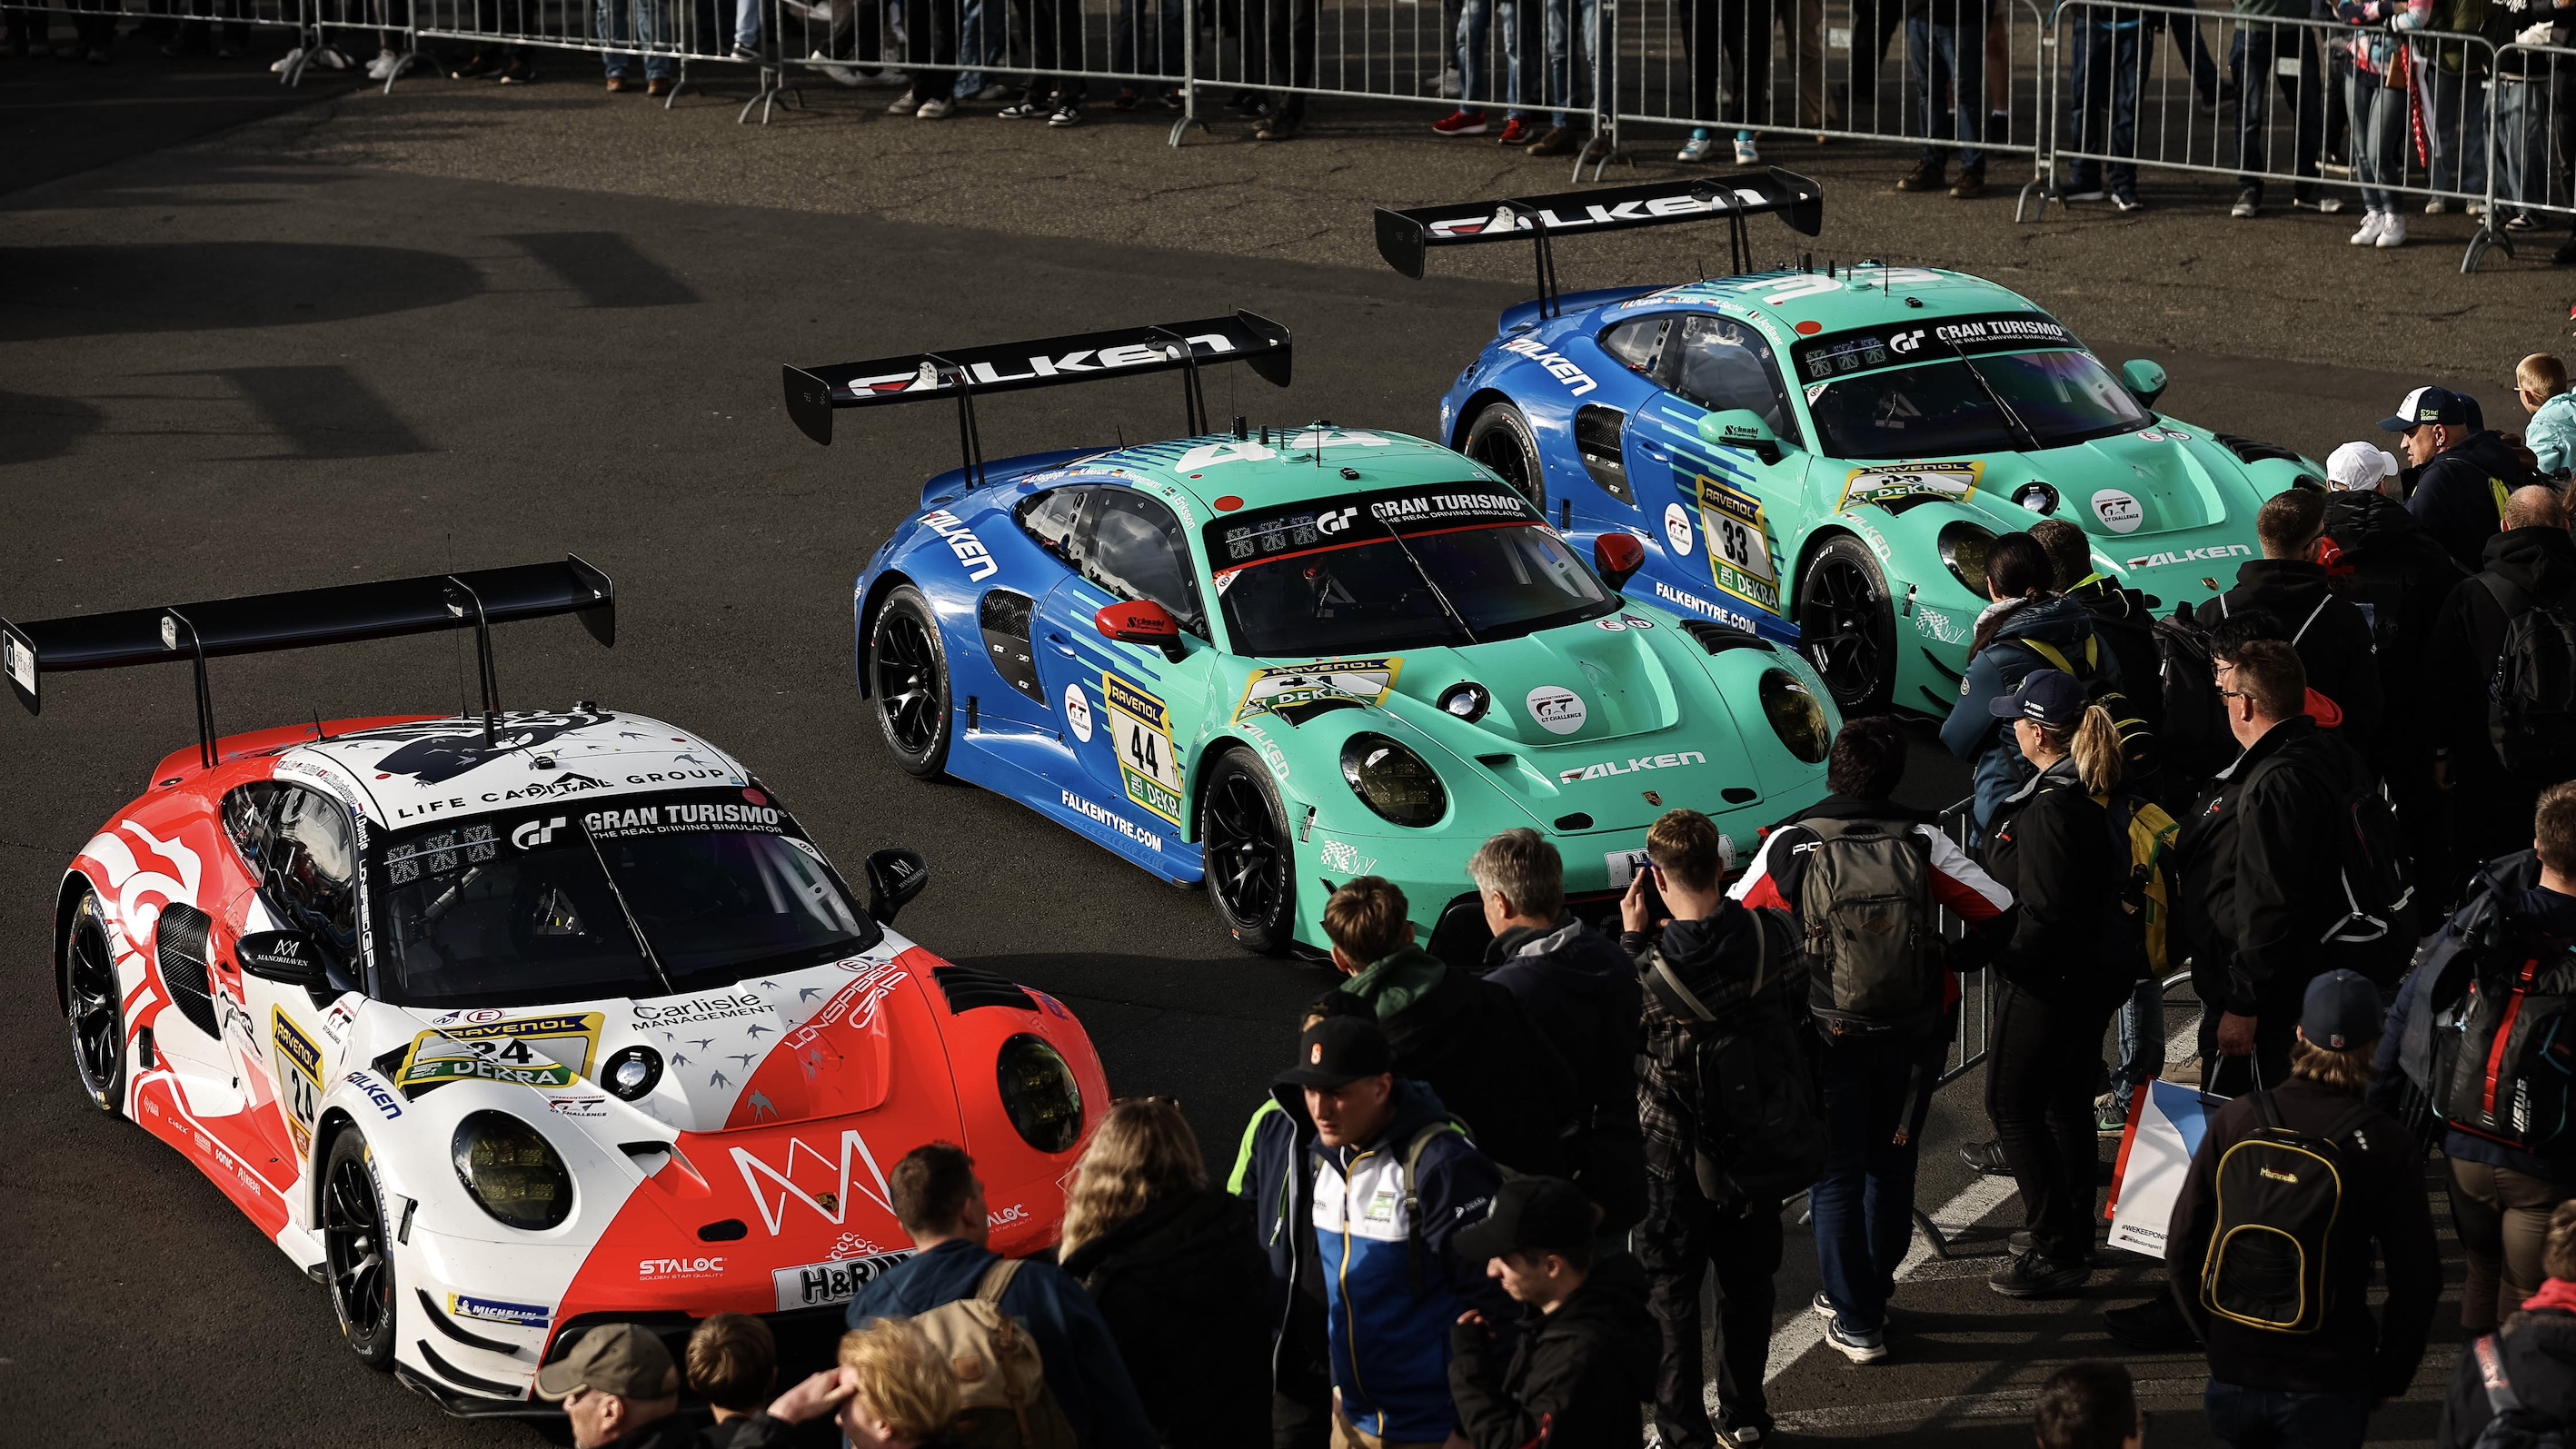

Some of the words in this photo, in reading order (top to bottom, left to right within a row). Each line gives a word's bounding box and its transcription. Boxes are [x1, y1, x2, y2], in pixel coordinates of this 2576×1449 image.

[1428, 188, 1768, 236] FALKEN
[1935, 322, 1986, 341] GRAN
[2023, 332, 2069, 342] SIMULATOR
[847, 332, 1238, 396] FALKEN
[1497, 338, 1598, 397] FALKEN
[1869, 462, 1965, 473] RAVENOL
[1169, 493, 1196, 531] J.Eriksson
[1370, 497, 1429, 520] GRAN
[1402, 513, 1430, 521] REAL
[1431, 510, 1471, 520] DRIVING
[1472, 509, 1527, 518] SIMULATOR
[1706, 488, 1755, 520] RAVENOL
[916, 509, 1000, 583] FALKEN
[1722, 518, 1748, 567] 33
[2124, 544, 2253, 571] FALKEN
[1736, 571, 1778, 610] DEKRA
[1656, 581, 1756, 634] FALKENTYRE.COM
[1272, 661, 1380, 675] RAVENOL
[1110, 685, 1160, 722] RAVENOL
[1550, 711, 1582, 721] CHALLENGE
[1130, 723, 1159, 779] 44
[1557, 750, 1707, 785] FALKEN
[397, 797, 466, 819] LIFE
[481, 777, 615, 801] CAPITAL
[625, 769, 725, 785] GROUP
[1147, 782, 1182, 819] DEKR
[584, 805, 659, 831] GRAN
[591, 830, 617, 839] THE
[620, 827, 655, 837] REAL
[658, 823, 709, 835] DRIVING
[713, 823, 783, 834] SIMULATOR
[1061, 789, 1163, 852] FALKENTYRE.COM
[256, 954, 309, 967] MANORHAVEN
[632, 993, 761, 1020] Carlisle
[632, 1004, 775, 1031] MANAGEMENT
[784, 963, 898, 1050] LIONSPEED
[445, 1018, 576, 1037] RAVENOL
[277, 1022, 315, 1071] RAVENOL
[466, 1038, 533, 1065] 24
[454, 1060, 560, 1085] DEKRA
[291, 1067, 314, 1125] 24
[343, 1070, 403, 1120] FALKEN
[2512, 1077, 2529, 1134] USWE
[562, 1109, 607, 1117] CHALLENGE
[214, 1148, 234, 1171] SONIC
[2260, 1166, 2299, 1185] Maranello
[986, 1203, 1029, 1228] ALOC
[2121, 1224, 2169, 1241] #WEKEEPONP
[2133, 1237, 2163, 1250] Motorsport
[639, 1256, 724, 1275] STALOC
[472, 1305, 537, 1321] MICHELIN
